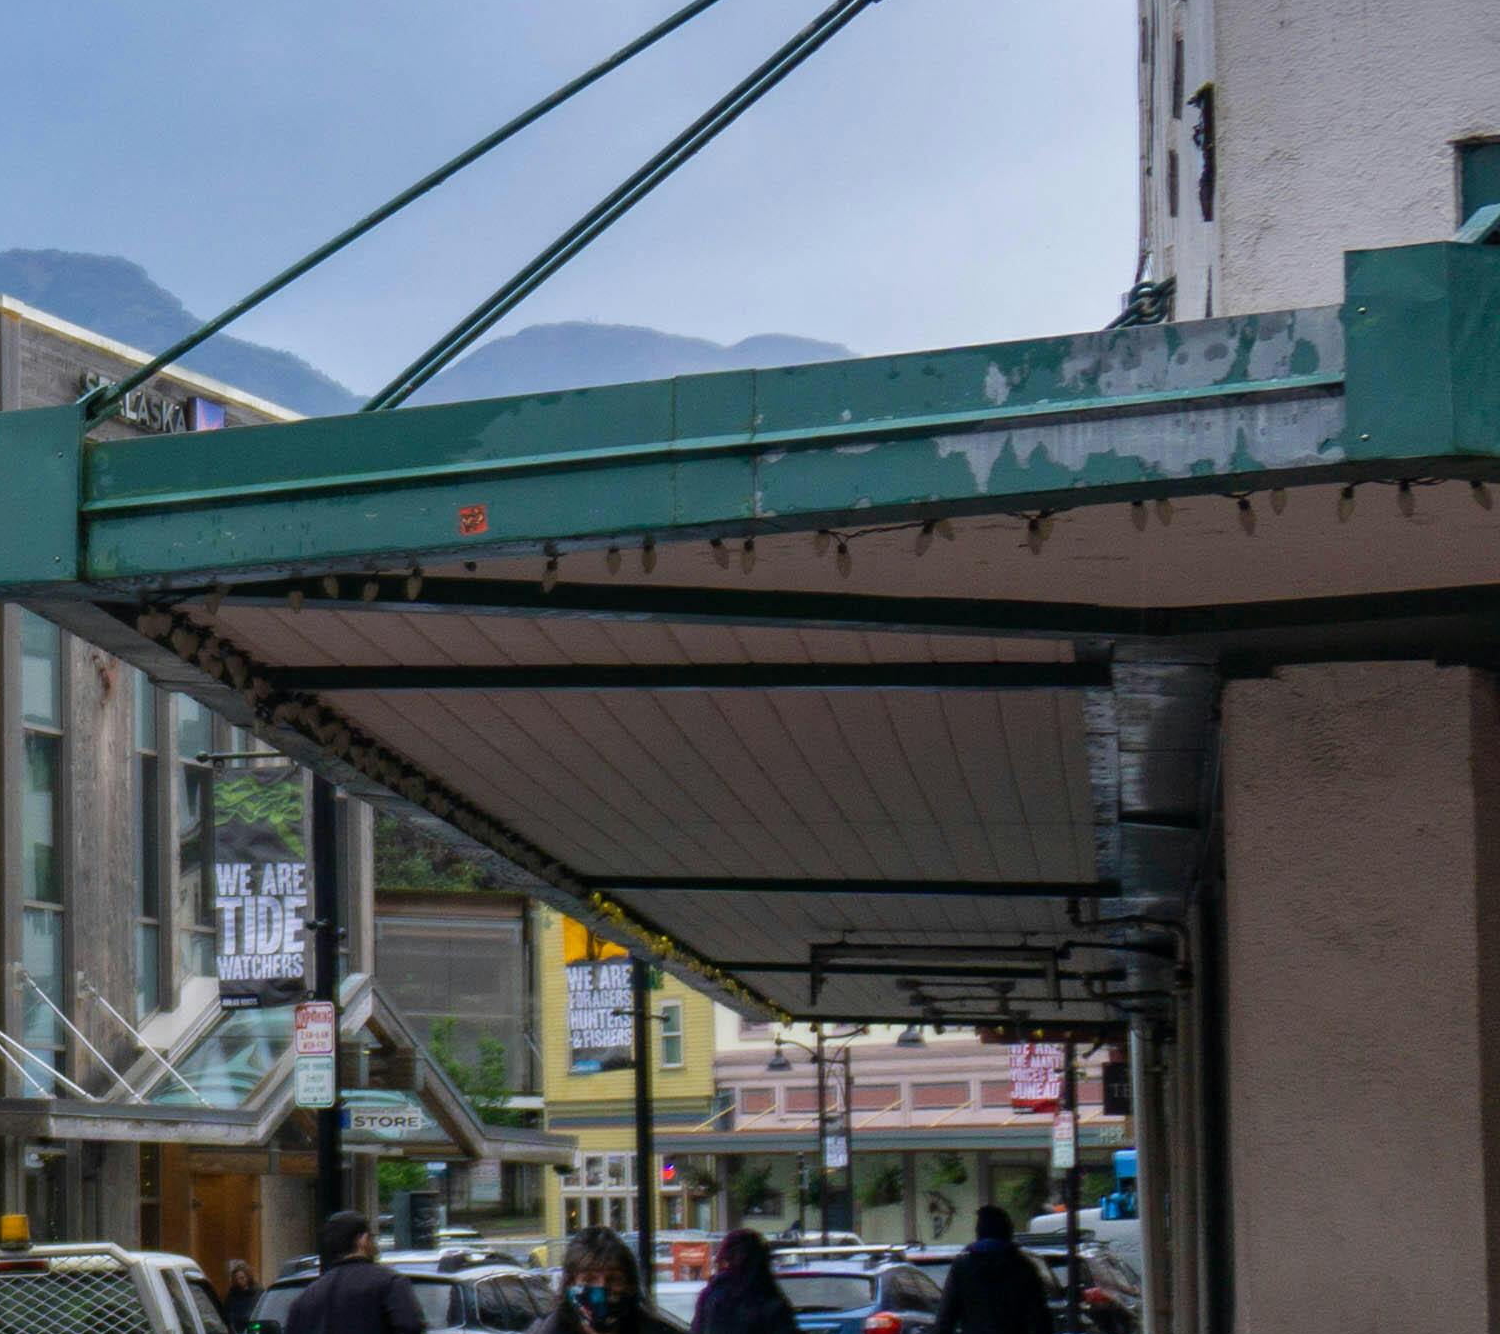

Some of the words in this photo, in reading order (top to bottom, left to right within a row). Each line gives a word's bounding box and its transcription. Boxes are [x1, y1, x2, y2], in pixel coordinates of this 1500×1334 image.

[215, 863, 252, 896] WE
[261, 862, 307, 896] ARE
[216, 896, 307, 955] TIDE
[216, 954, 304, 980] WATCHERS
[566, 966, 594, 990] WE
[600, 965, 632, 989] ARE
[354, 1115, 420, 1128] STORE
